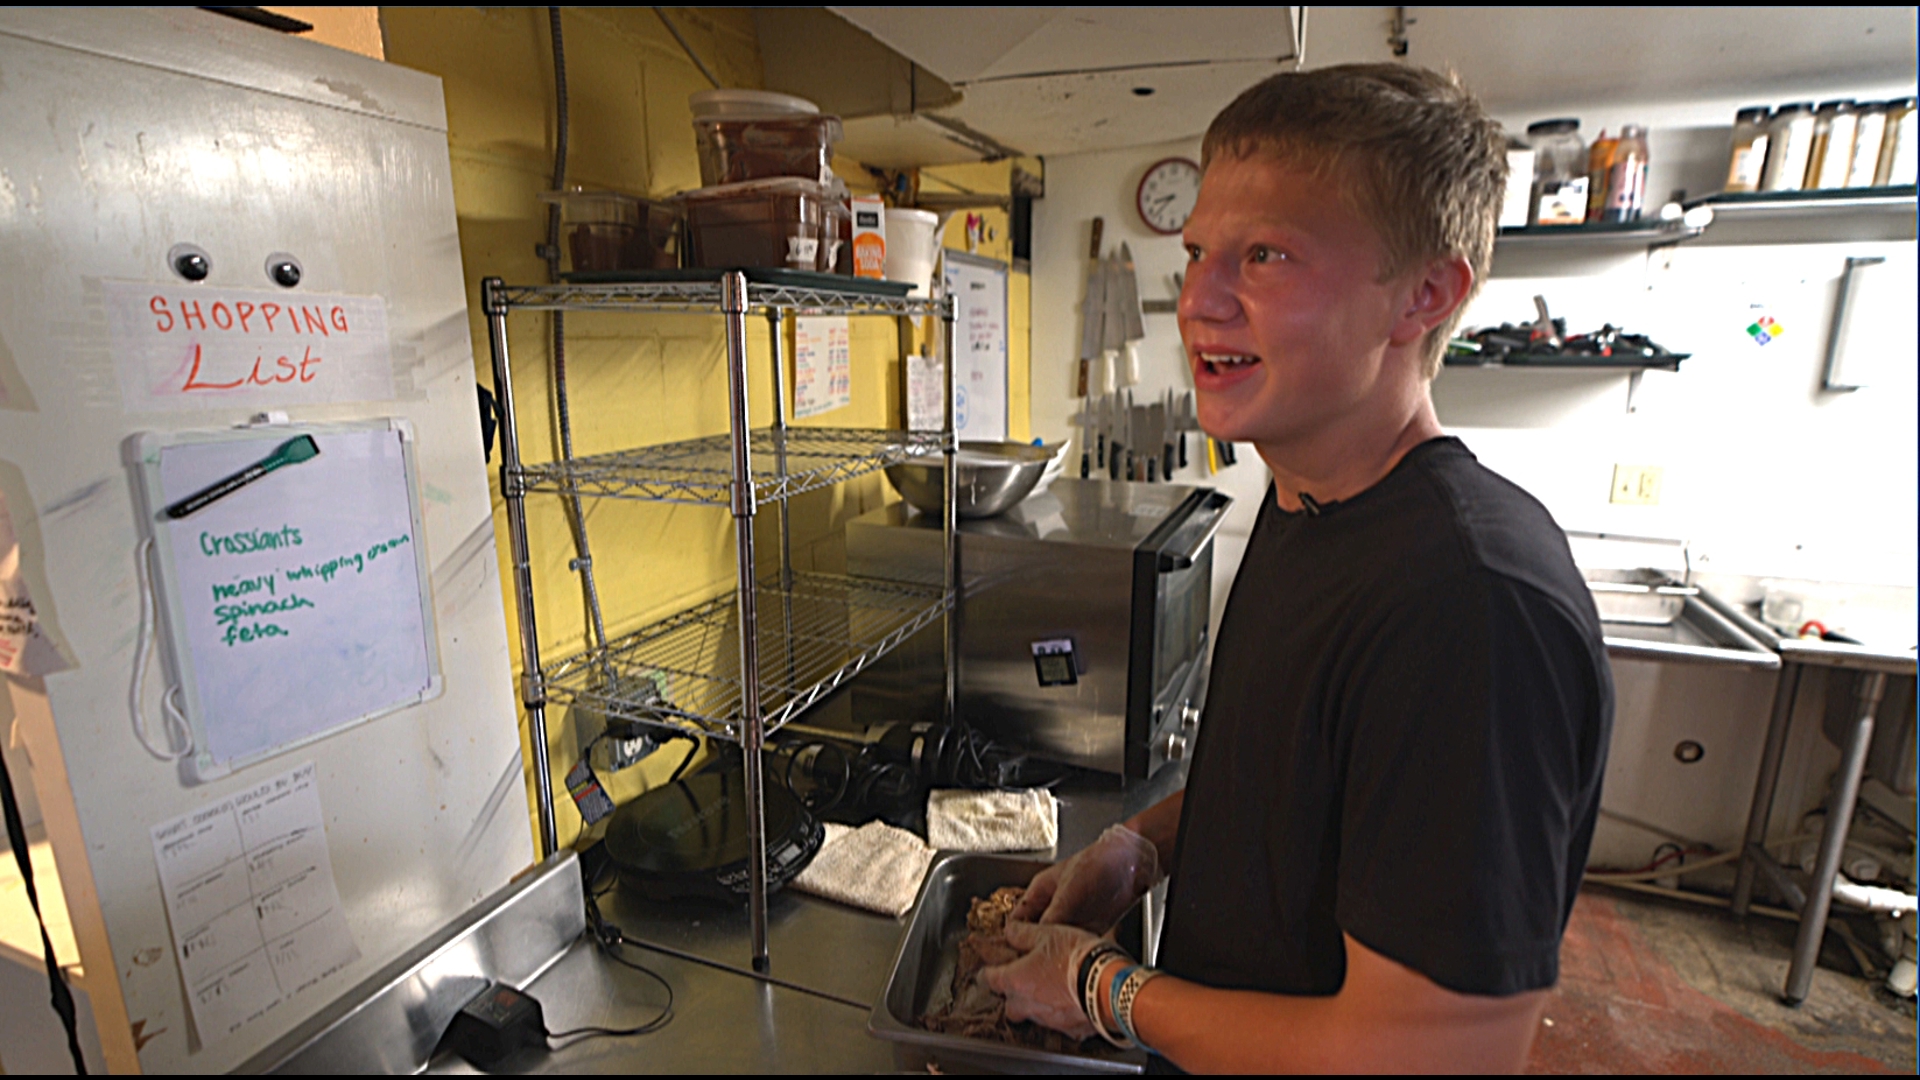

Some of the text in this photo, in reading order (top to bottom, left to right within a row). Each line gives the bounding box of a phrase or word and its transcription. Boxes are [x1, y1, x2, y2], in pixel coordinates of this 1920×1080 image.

[860, 258, 880, 270] SODA
[150, 295, 349, 336] SHOPPING
[182, 343, 322, 392] List
[286, 552, 364, 583] whipping
[213, 594, 315, 626] spinach
